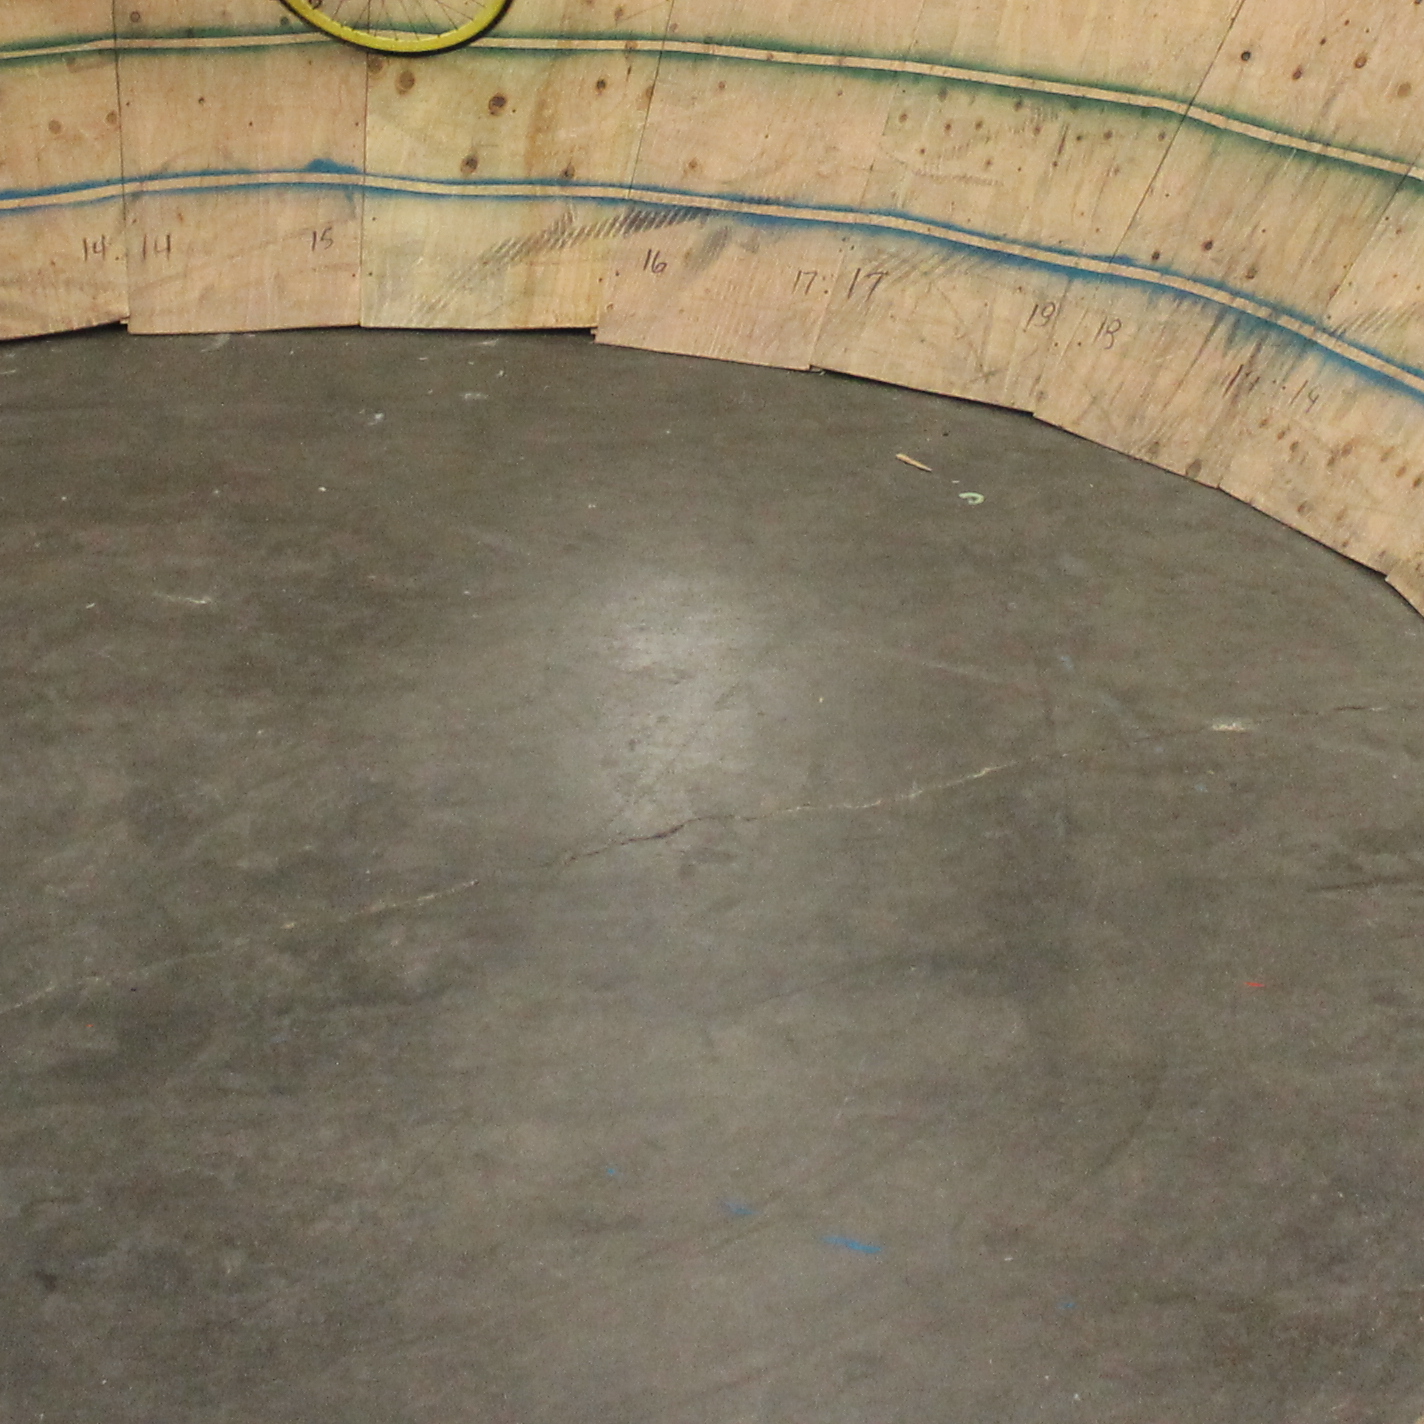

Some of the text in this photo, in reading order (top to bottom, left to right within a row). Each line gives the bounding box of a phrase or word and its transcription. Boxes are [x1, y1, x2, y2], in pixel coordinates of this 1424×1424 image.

[83, 233, 171, 262] 14 14
[312, 226, 334, 252] 15
[643, 248, 668, 274] 16
[792, 267, 889, 303] 17 17
